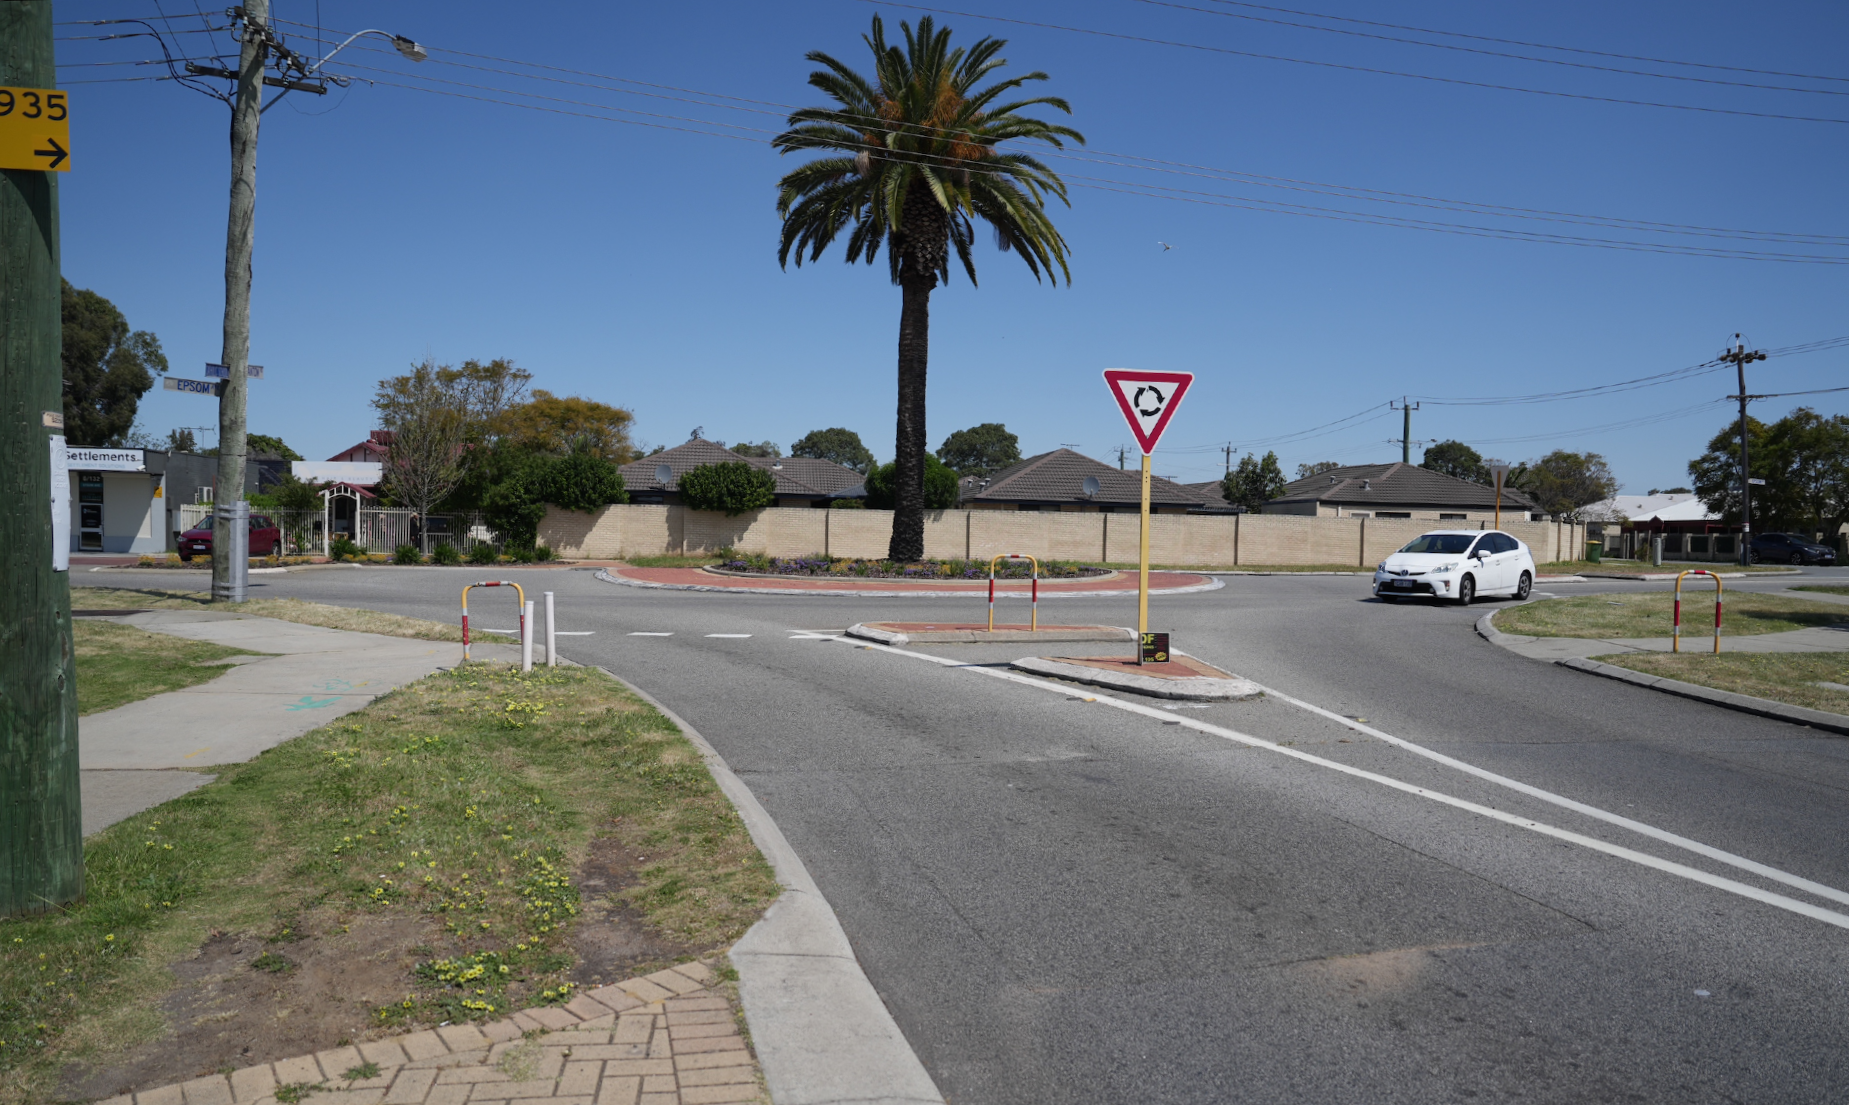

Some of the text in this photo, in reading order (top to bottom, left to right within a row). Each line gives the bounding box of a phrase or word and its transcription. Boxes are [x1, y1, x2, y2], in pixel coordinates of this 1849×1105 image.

[0, 89, 67, 121] 935
[177, 380, 210, 394] EPSOM
[66, 451, 136, 462] Settlements
